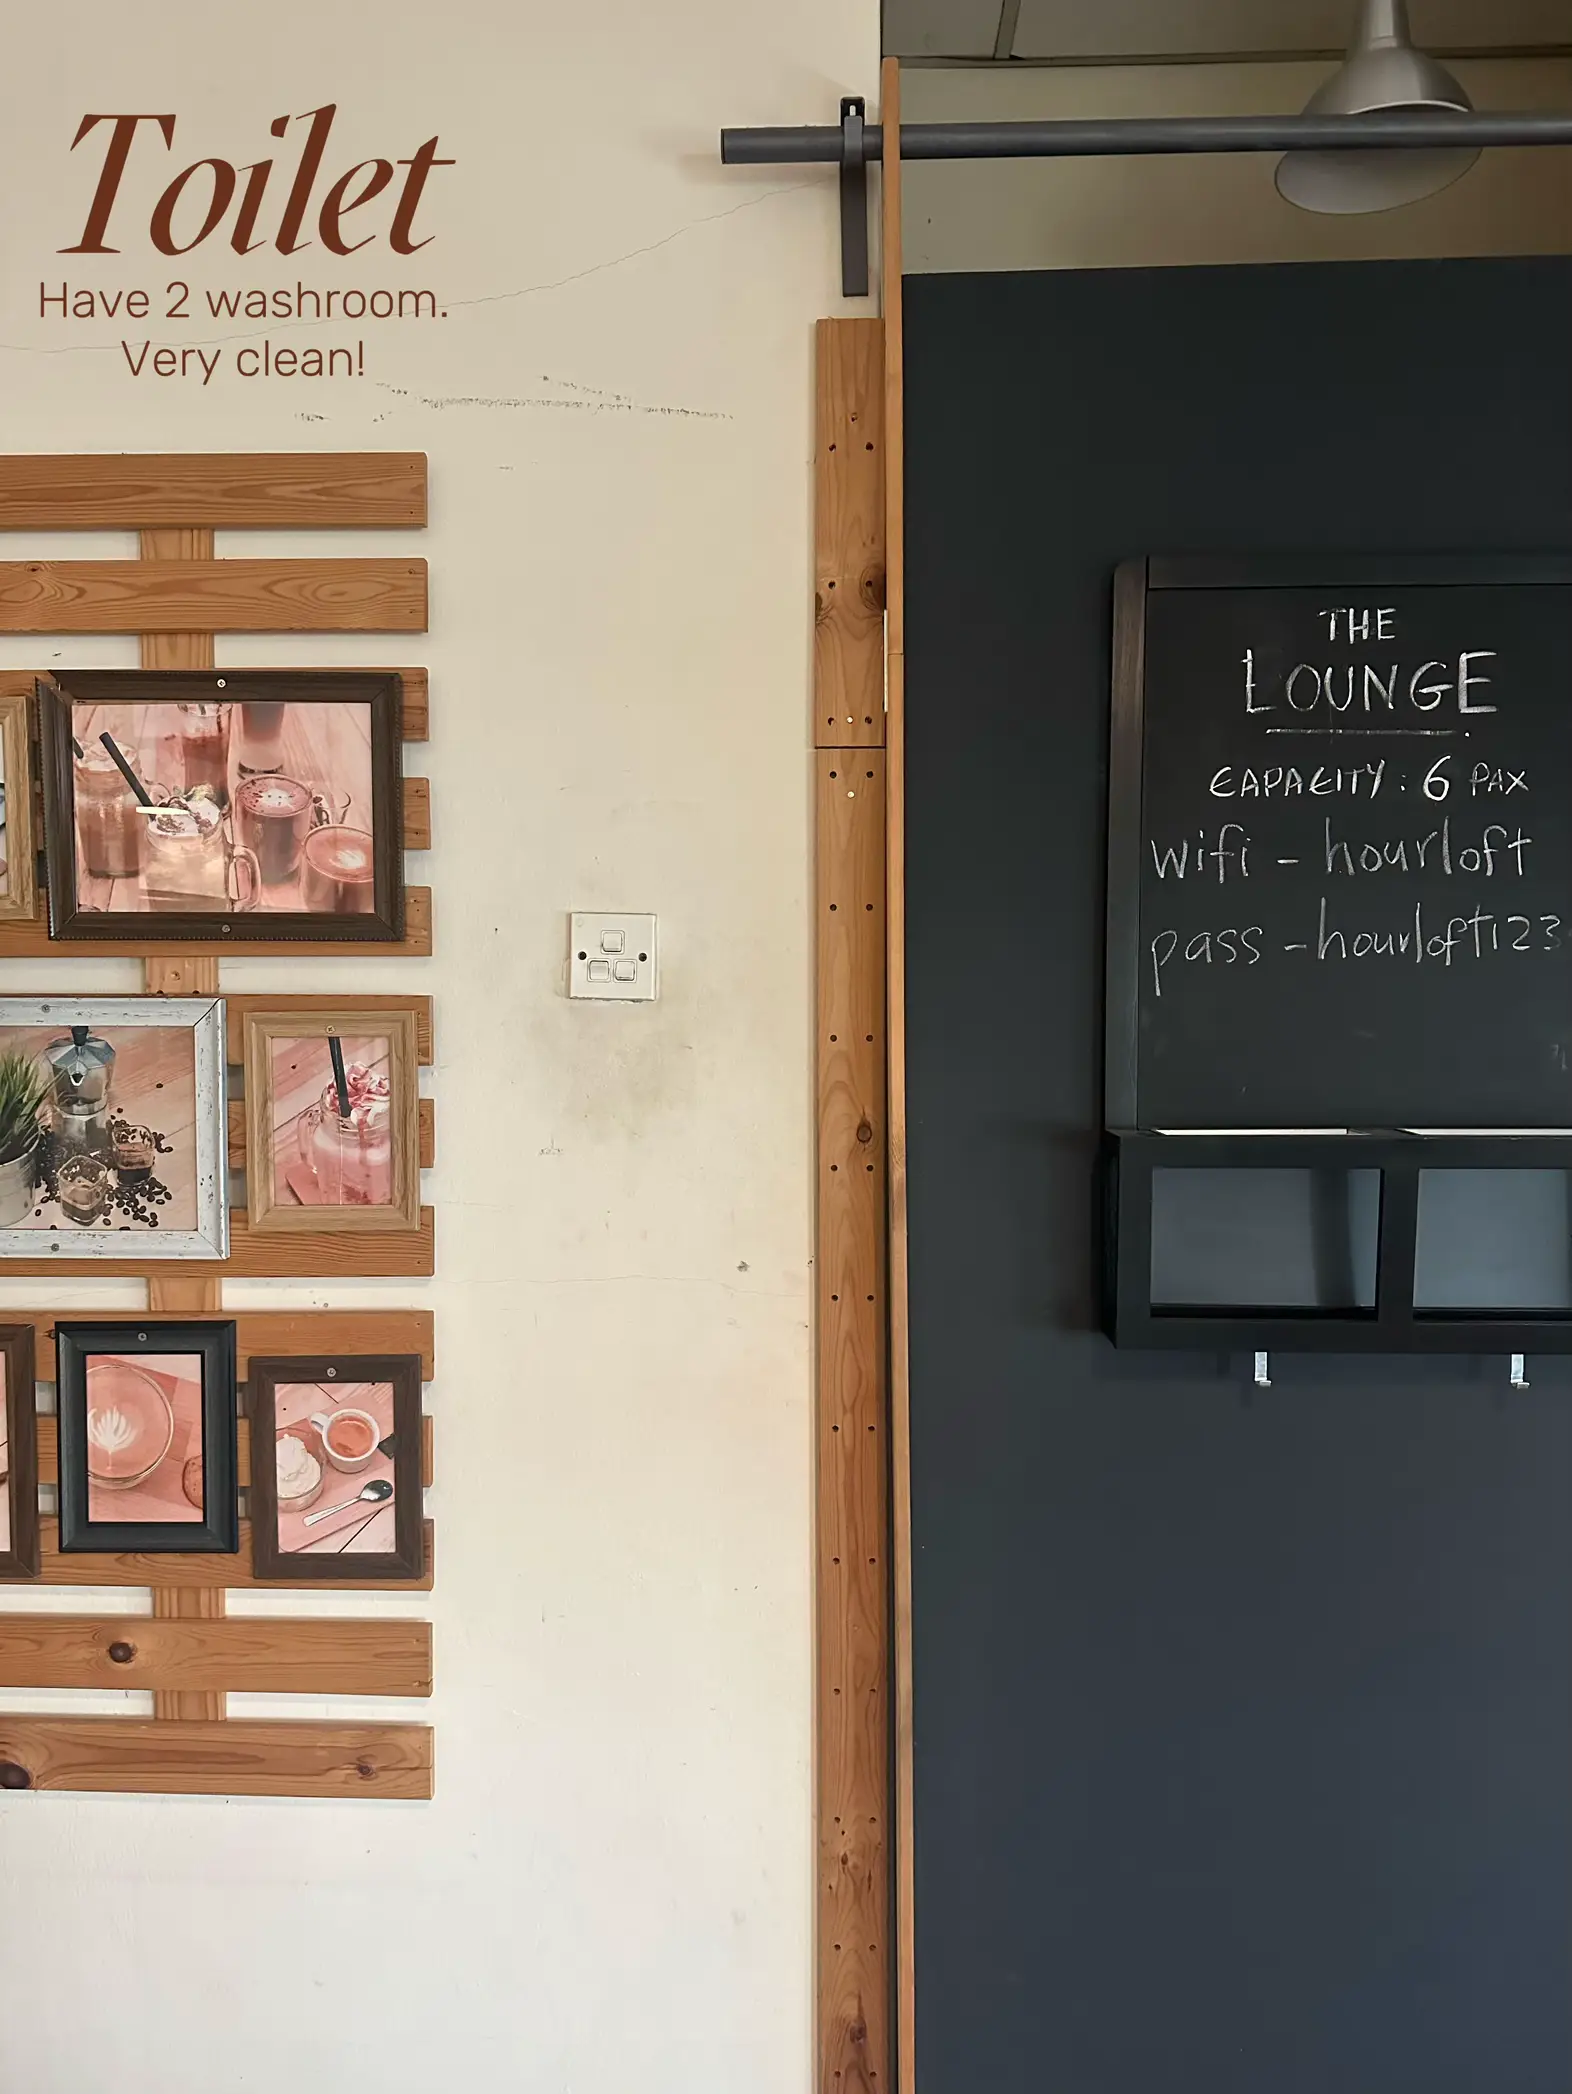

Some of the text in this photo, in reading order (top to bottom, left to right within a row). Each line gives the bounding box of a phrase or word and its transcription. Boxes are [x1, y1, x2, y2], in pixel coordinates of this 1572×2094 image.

[1316, 607, 1397, 644] THE
[1240, 648, 1499, 714] LOUNGE
[1421, 755, 1451, 801] 6
[1469, 762, 1531, 795] PAX
[1150, 823, 1252, 884] wifi
[1324, 816, 1533, 877] hourloft
[1150, 926, 1263, 997] pass
